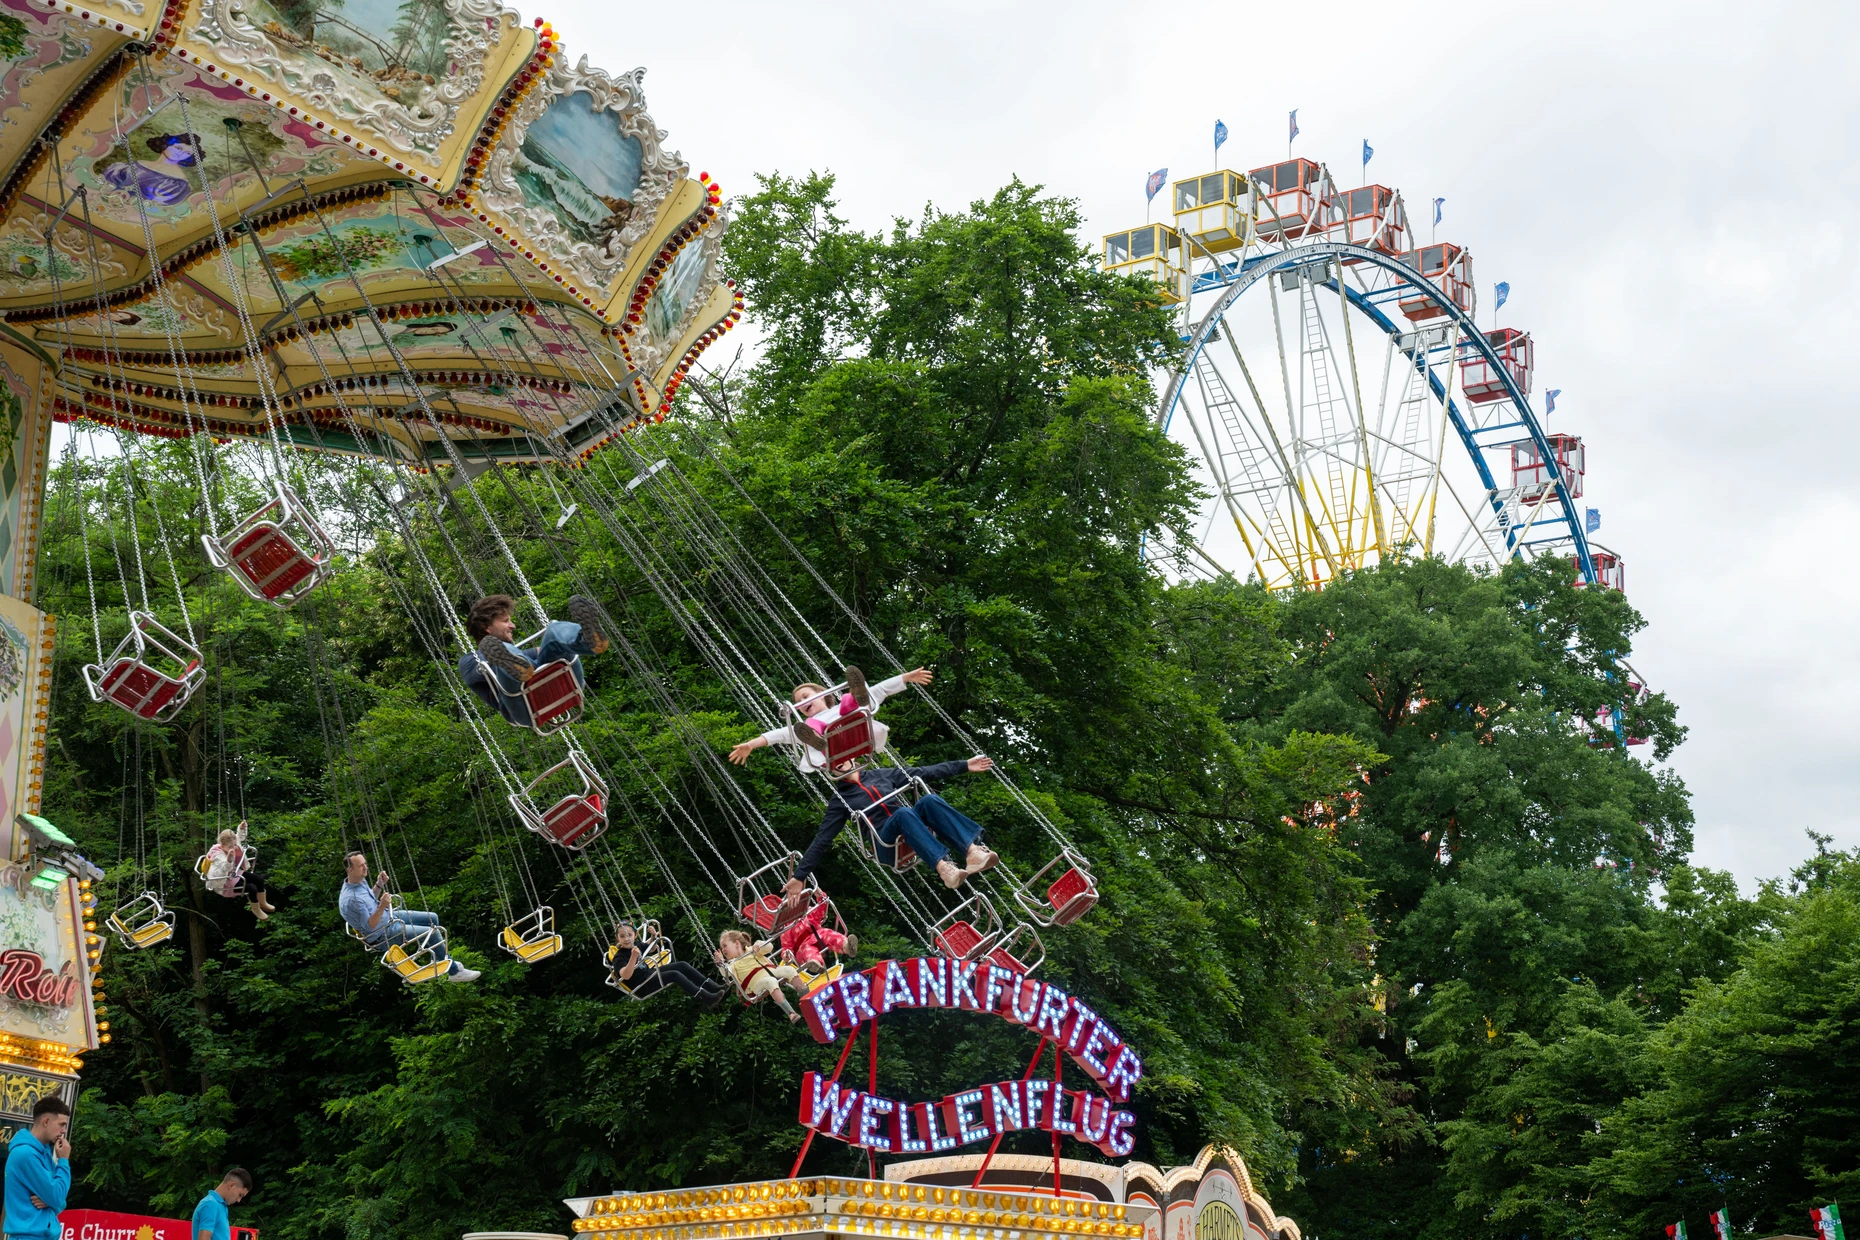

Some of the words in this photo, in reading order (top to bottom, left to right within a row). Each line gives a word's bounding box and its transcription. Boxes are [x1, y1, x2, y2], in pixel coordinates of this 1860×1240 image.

[800, 957, 1142, 1101] FRANKFURTER
[800, 1071, 1137, 1157] WELLENFLUG
[81, 1223, 165, 1240] Churrs
